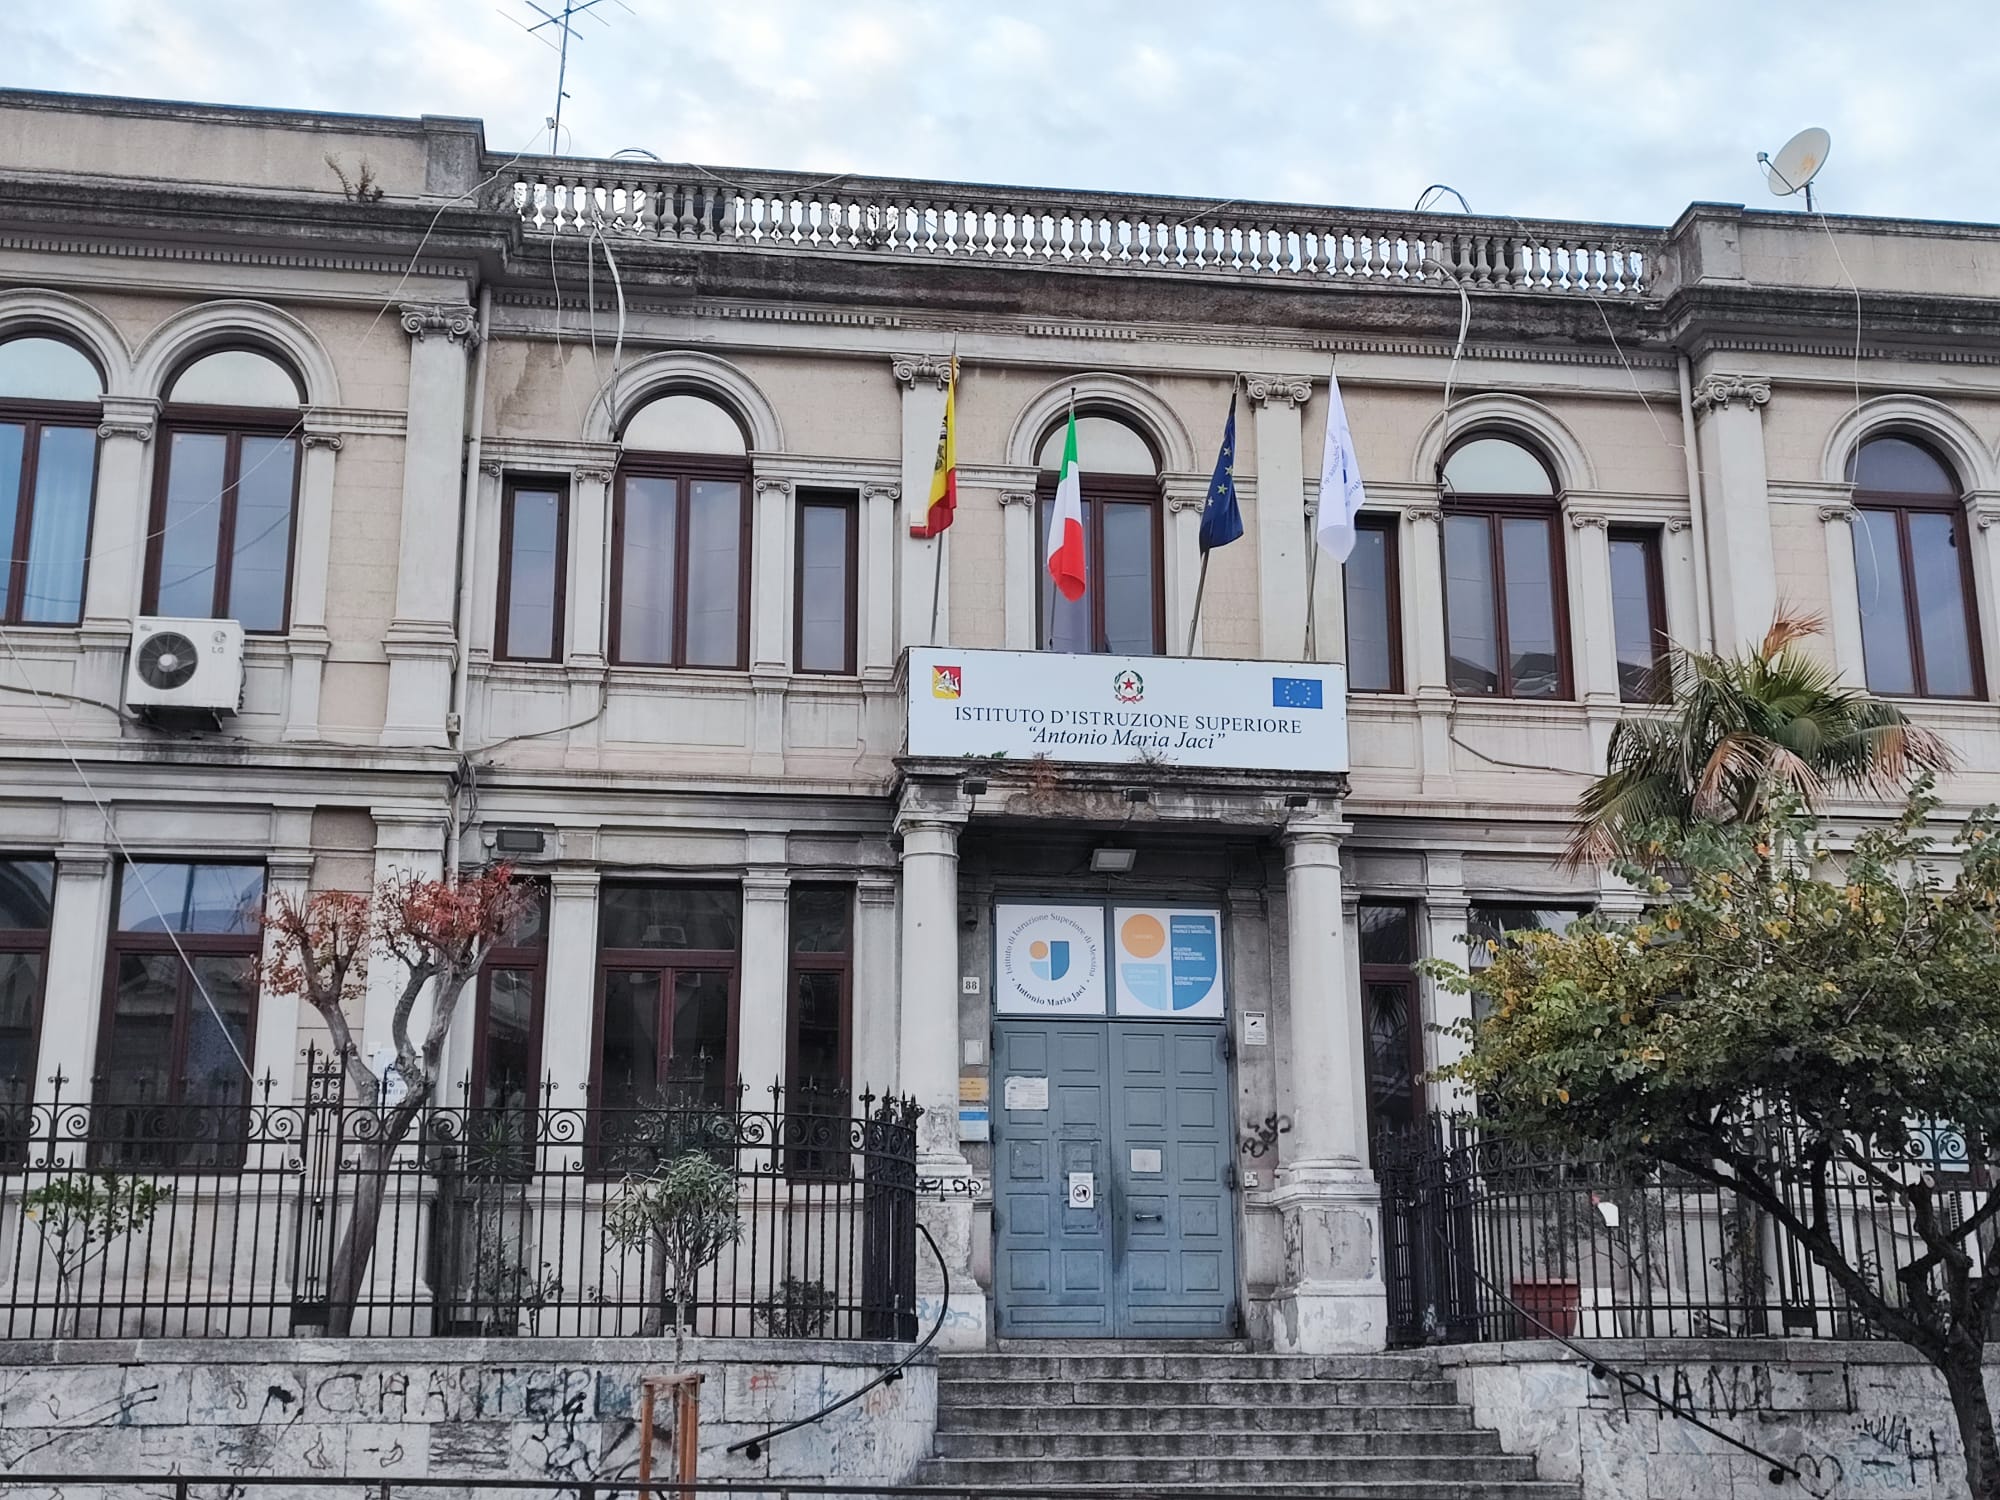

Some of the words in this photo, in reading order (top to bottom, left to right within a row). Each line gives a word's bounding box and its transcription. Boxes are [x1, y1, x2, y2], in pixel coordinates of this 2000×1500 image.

[211, 646, 225, 654] LG
[955, 706, 1044, 724] ISTITUTO
[1050, 710, 1189, 730] D’ISTRUZIONE
[1195, 716, 1302, 734] SUPERIORE
[1029, 726, 1107, 746] “Antonio
[1112, 729, 1169, 748] Maria
[1174, 731, 1226, 749] Jaci”
[1012, 914, 1049, 937] Istruzione
[1050, 913, 1086, 935] Superiore
[1015, 983, 1045, 1005] Antonio
[1047, 996, 1072, 1007] Maria
[1071, 984, 1087, 1001] Jaci
